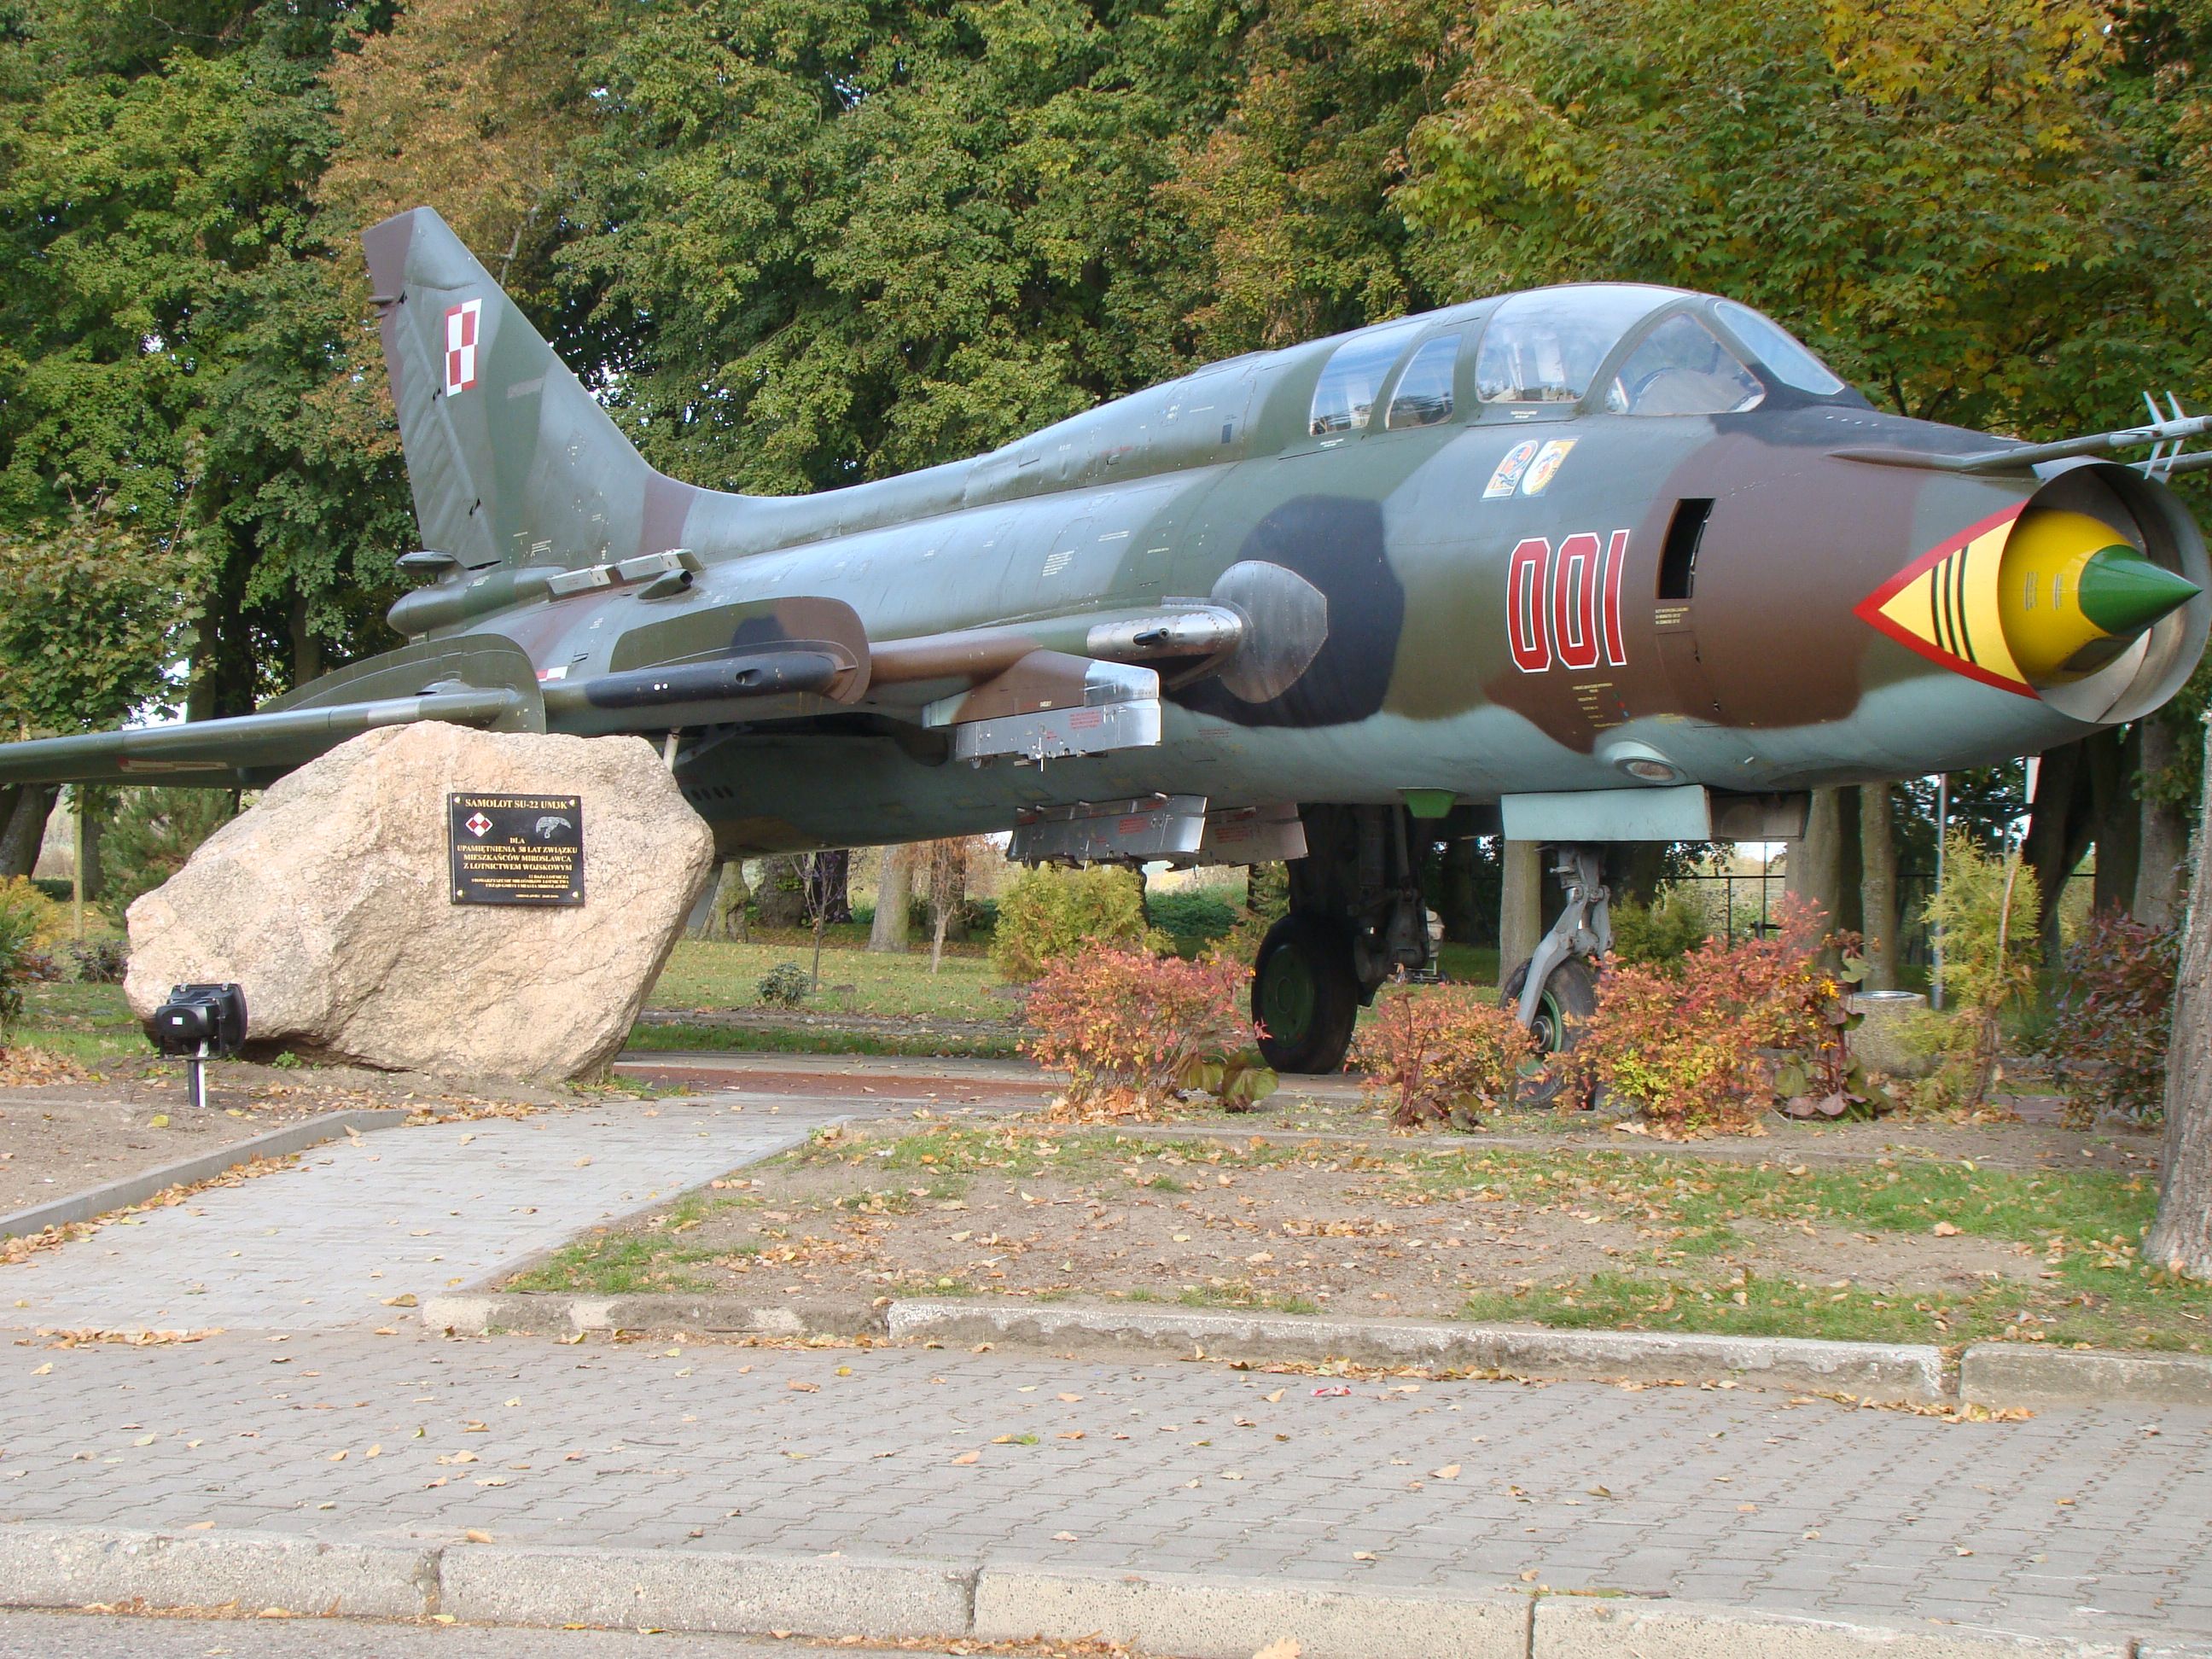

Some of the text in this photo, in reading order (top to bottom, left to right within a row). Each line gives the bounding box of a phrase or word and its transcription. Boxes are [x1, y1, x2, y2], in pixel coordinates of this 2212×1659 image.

[1506, 529, 1631, 673] 001
[465, 799, 568, 810] SAMOLOT SU-22 UM3K
[457, 845, 515, 853] UPAMIĘTNIENIA
[463, 853, 520, 862] MIESZKAŃCÓW
